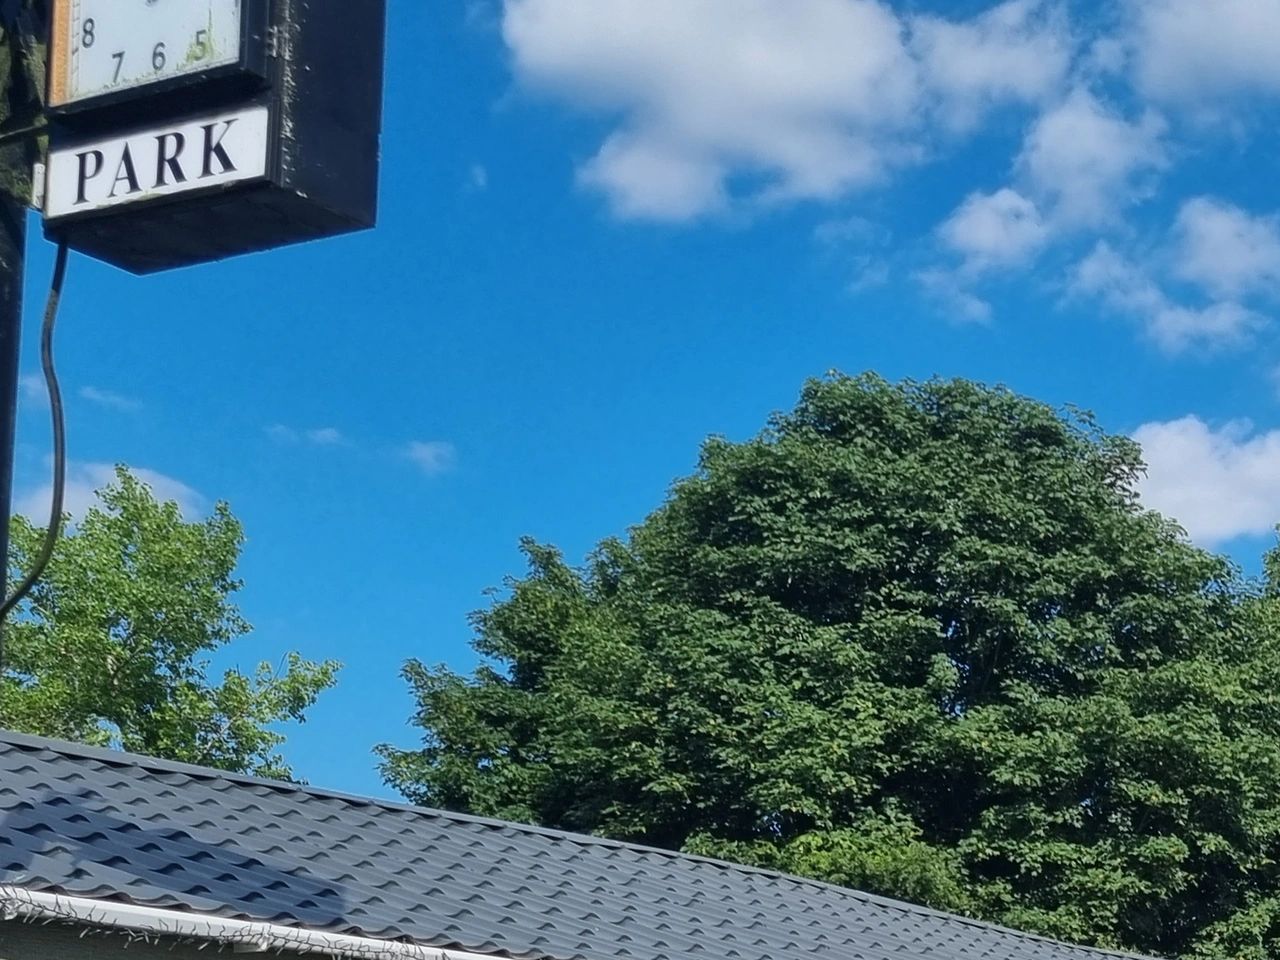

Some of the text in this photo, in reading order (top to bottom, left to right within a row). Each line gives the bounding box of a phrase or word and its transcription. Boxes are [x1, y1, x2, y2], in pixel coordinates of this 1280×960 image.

[81, 18, 95, 49] 8
[195, 30, 206, 61] 5
[112, 51, 125, 83] 7
[152, 42, 166, 71] 6
[72, 118, 239, 206] PARK
